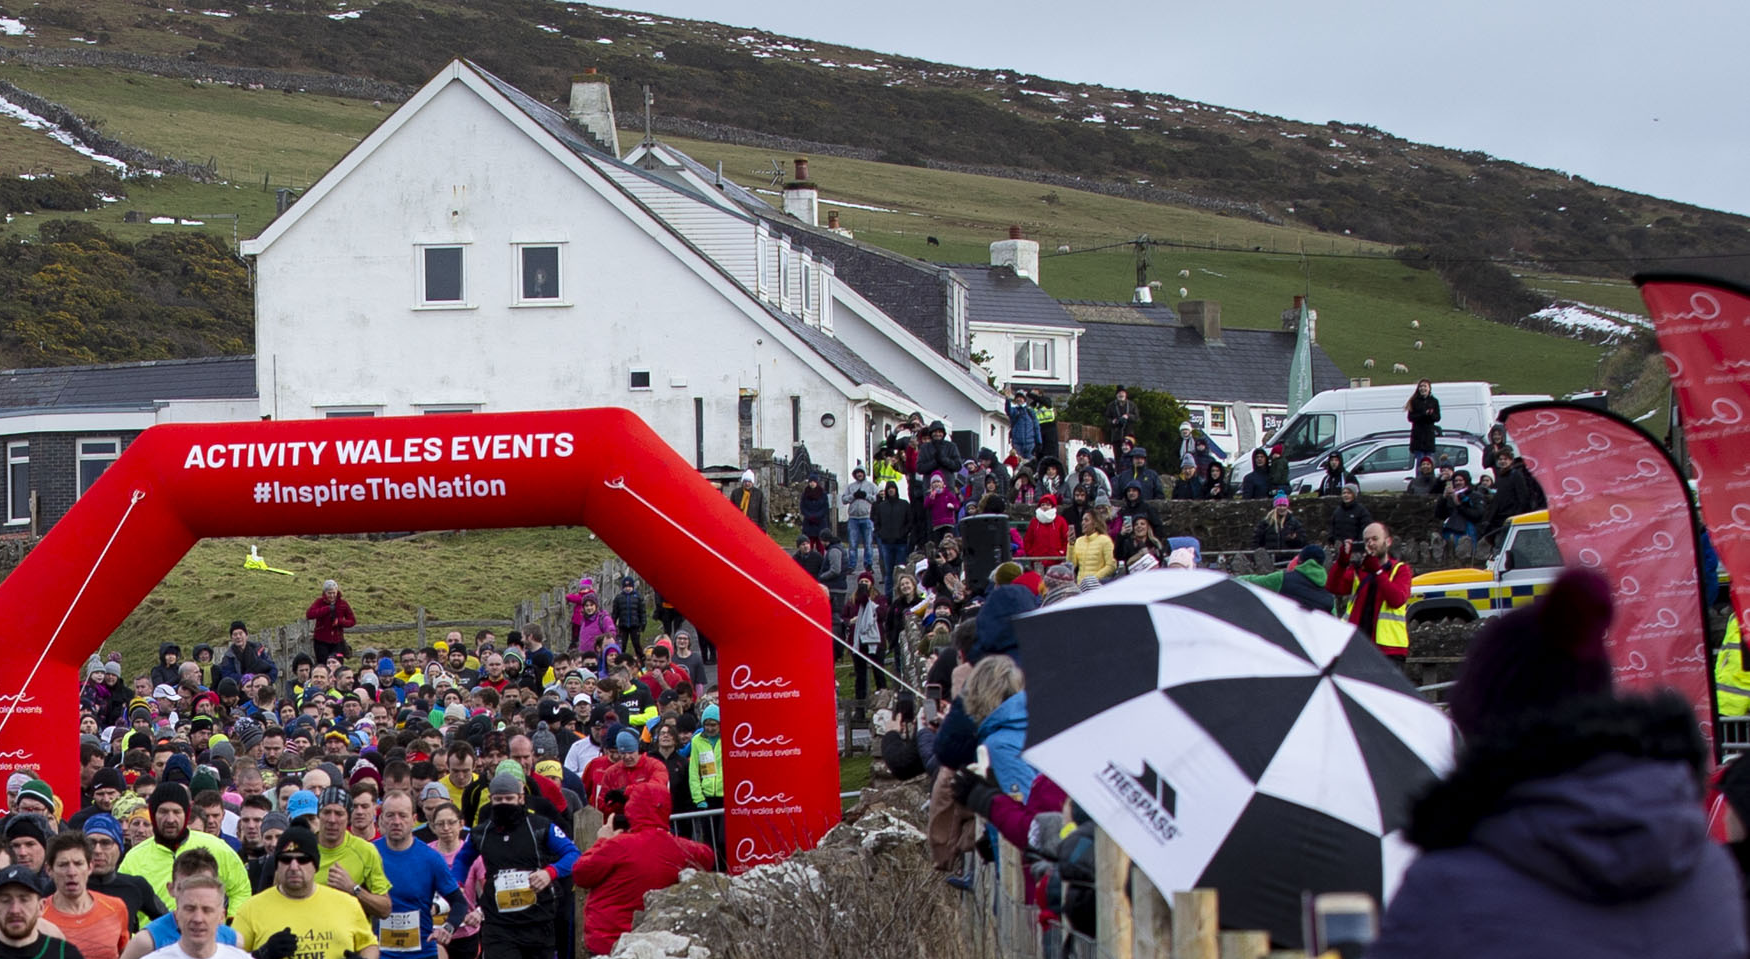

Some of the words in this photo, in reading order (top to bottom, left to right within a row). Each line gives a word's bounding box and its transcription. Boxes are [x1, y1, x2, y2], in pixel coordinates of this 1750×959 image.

[184, 441, 327, 469] ACTIVITY
[335, 437, 443, 465] WALES
[451, 432, 574, 461] EVENTS
[253, 474, 506, 507] #InspireTheNation
[750, 691, 772, 700] wales
[773, 689, 801, 699] events
[751, 749, 773, 757] wales
[774, 747, 801, 756] events
[1102, 761, 1178, 840] TRESPASS
